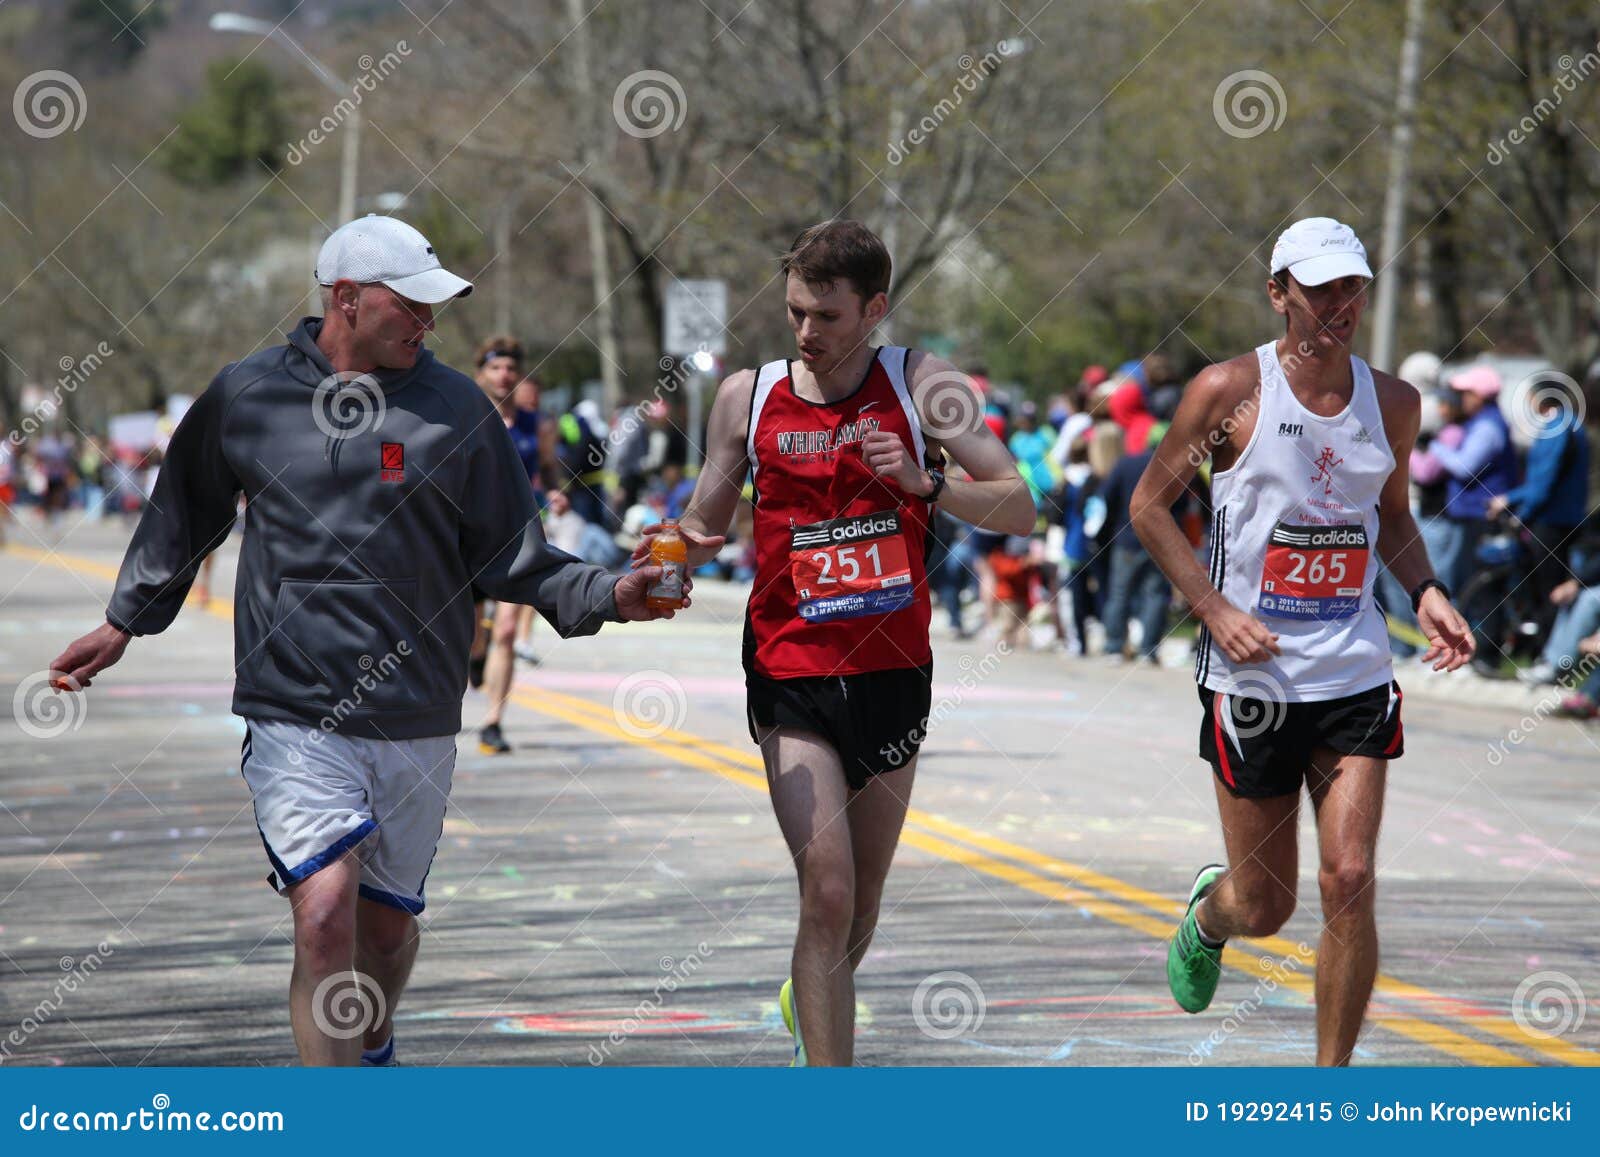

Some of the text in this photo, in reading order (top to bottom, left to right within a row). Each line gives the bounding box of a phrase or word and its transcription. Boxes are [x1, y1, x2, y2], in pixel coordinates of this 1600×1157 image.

[832, 519, 898, 541] adidas
[1311, 530, 1365, 545] adidas
[812, 543, 882, 584] 251
[1284, 553, 1347, 584] 265
[818, 600, 835, 608] 2011
[836, 597, 864, 606] BOSTON
[819, 603, 865, 615] MARATHON
[1279, 598, 1294, 606] 2011
[1296, 600, 1320, 608] BOSTON
[1278, 605, 1320, 614] MARATHON
